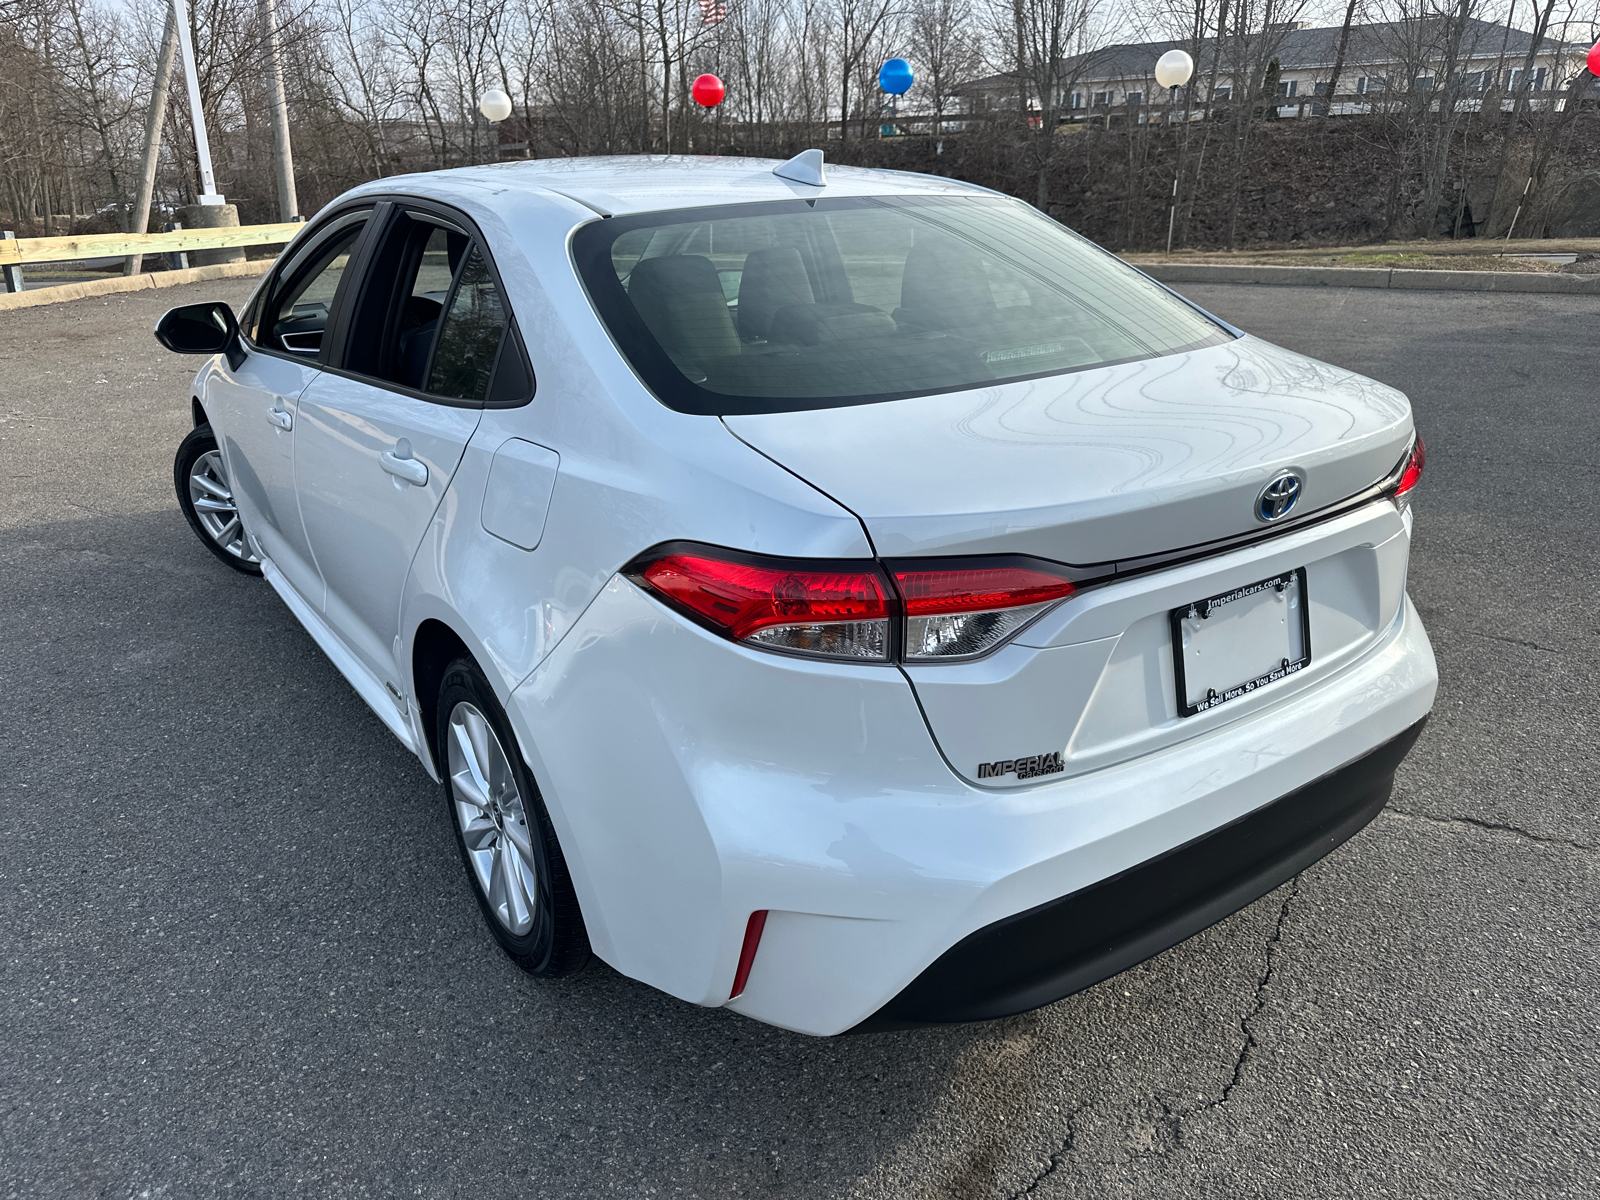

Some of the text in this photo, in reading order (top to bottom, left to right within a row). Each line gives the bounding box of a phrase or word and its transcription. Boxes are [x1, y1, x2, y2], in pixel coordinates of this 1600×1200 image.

[1207, 577, 1281, 609] Imperialcars.com
[1195, 662, 1302, 712] We Sell More, So You Save More
[978, 751, 1064, 778] IMPERIAL
[1017, 765, 1064, 780] cars.com
